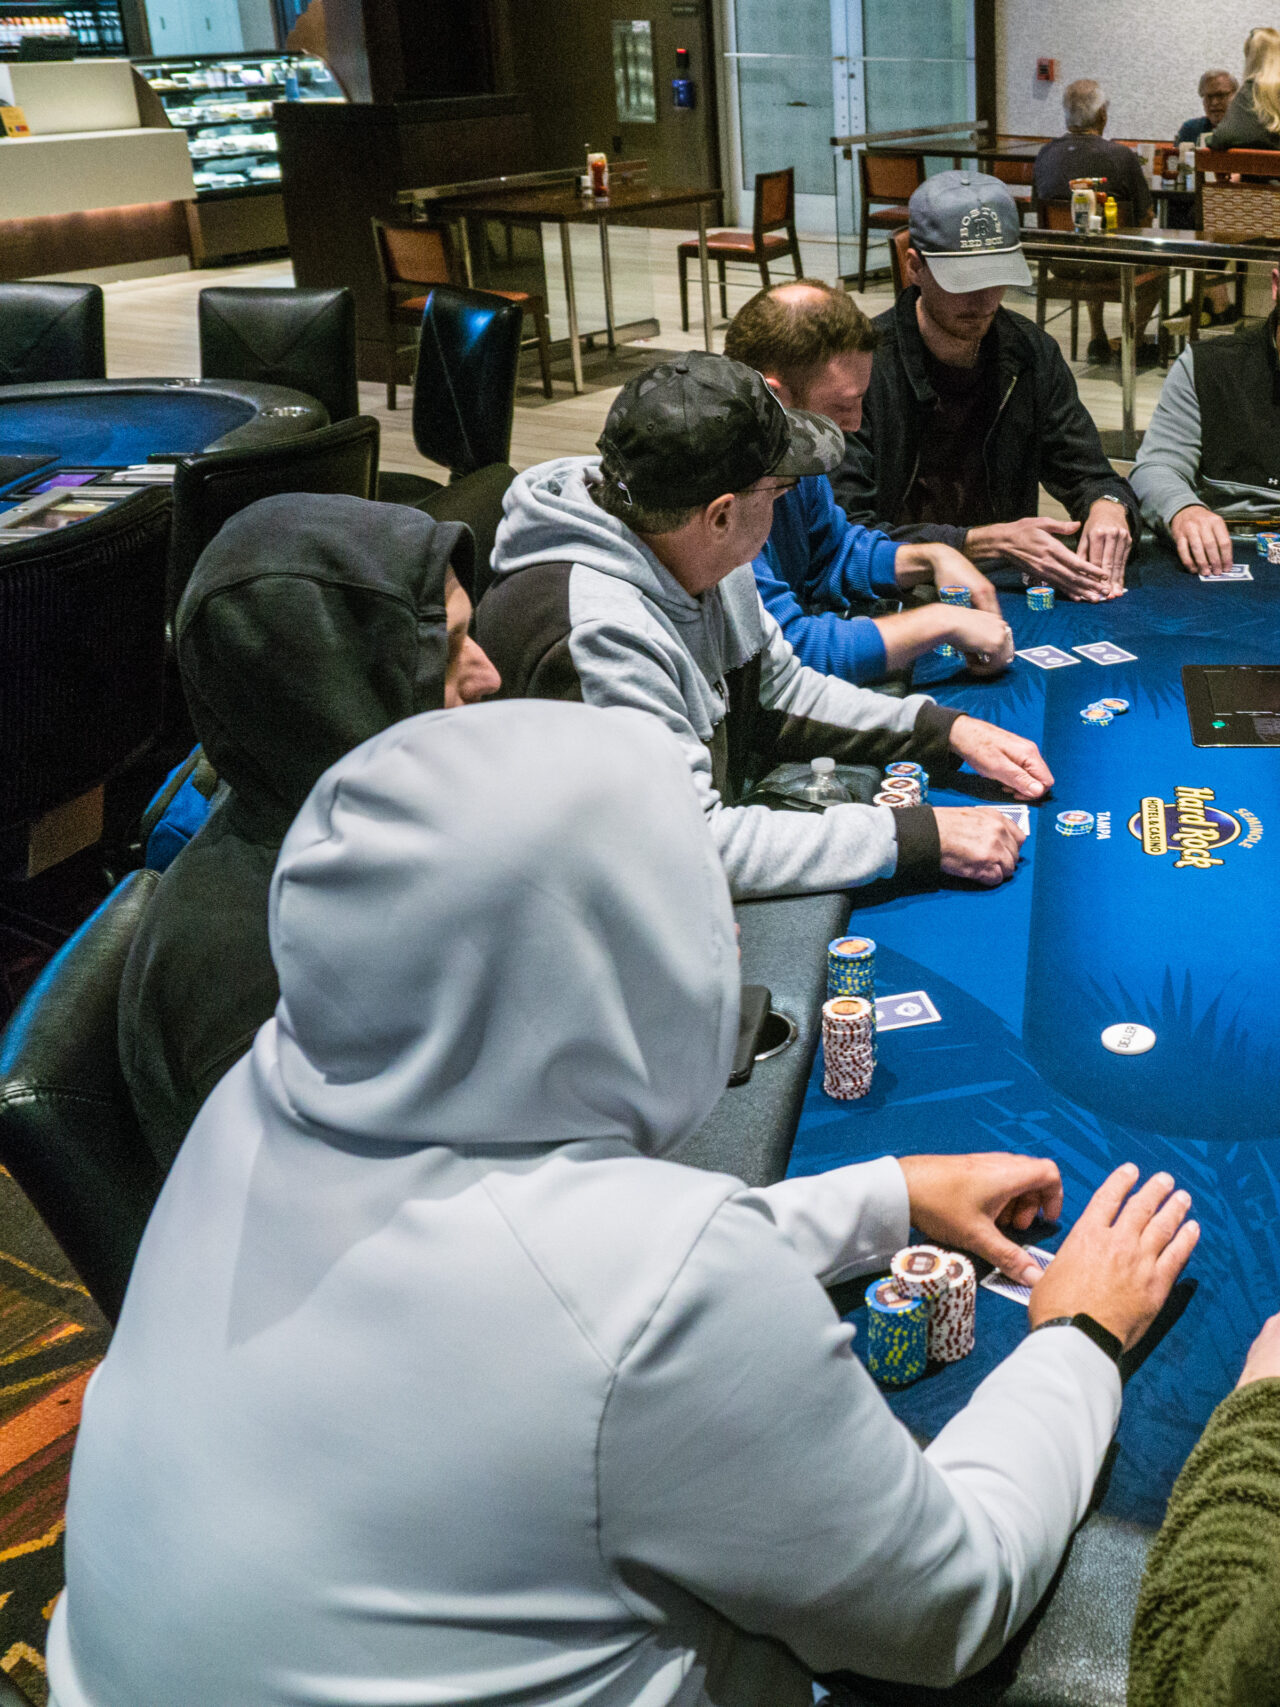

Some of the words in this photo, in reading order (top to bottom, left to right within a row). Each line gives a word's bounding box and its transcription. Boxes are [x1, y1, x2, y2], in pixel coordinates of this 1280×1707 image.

[959, 239, 982, 248] RED
[1146, 799, 1160, 820] HOTEL
[1173, 785, 1220, 827] Hard
[1096, 811, 1112, 840] TAMPA
[1149, 826, 1162, 853] CASINO
[1233, 807, 1264, 849] SEMINOLE
[1171, 826, 1226, 869] Rock
[1116, 1025, 1138, 1049] DEALER
